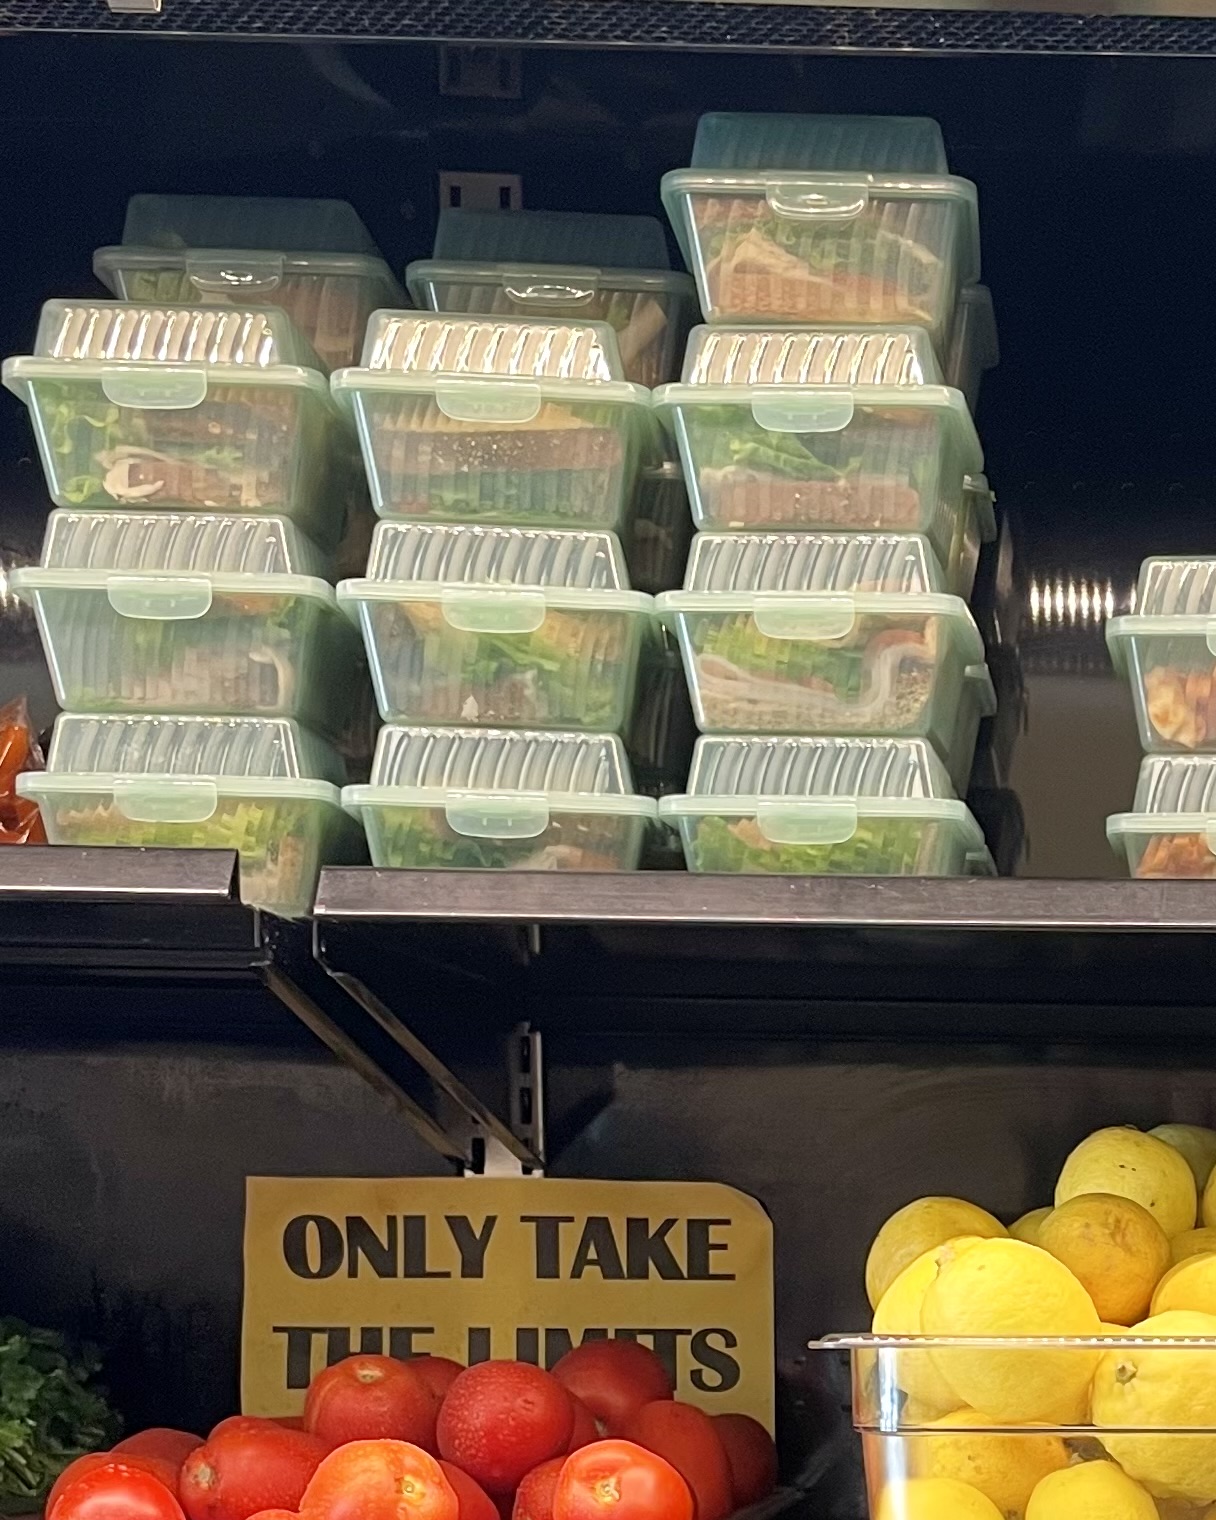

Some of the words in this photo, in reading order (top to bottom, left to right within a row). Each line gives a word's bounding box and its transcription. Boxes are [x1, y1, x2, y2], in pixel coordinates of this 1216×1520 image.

[282, 1214, 498, 1280] ONLY
[520, 1215, 737, 1281] TAKE
[467, 1326, 741, 1393] ITS
